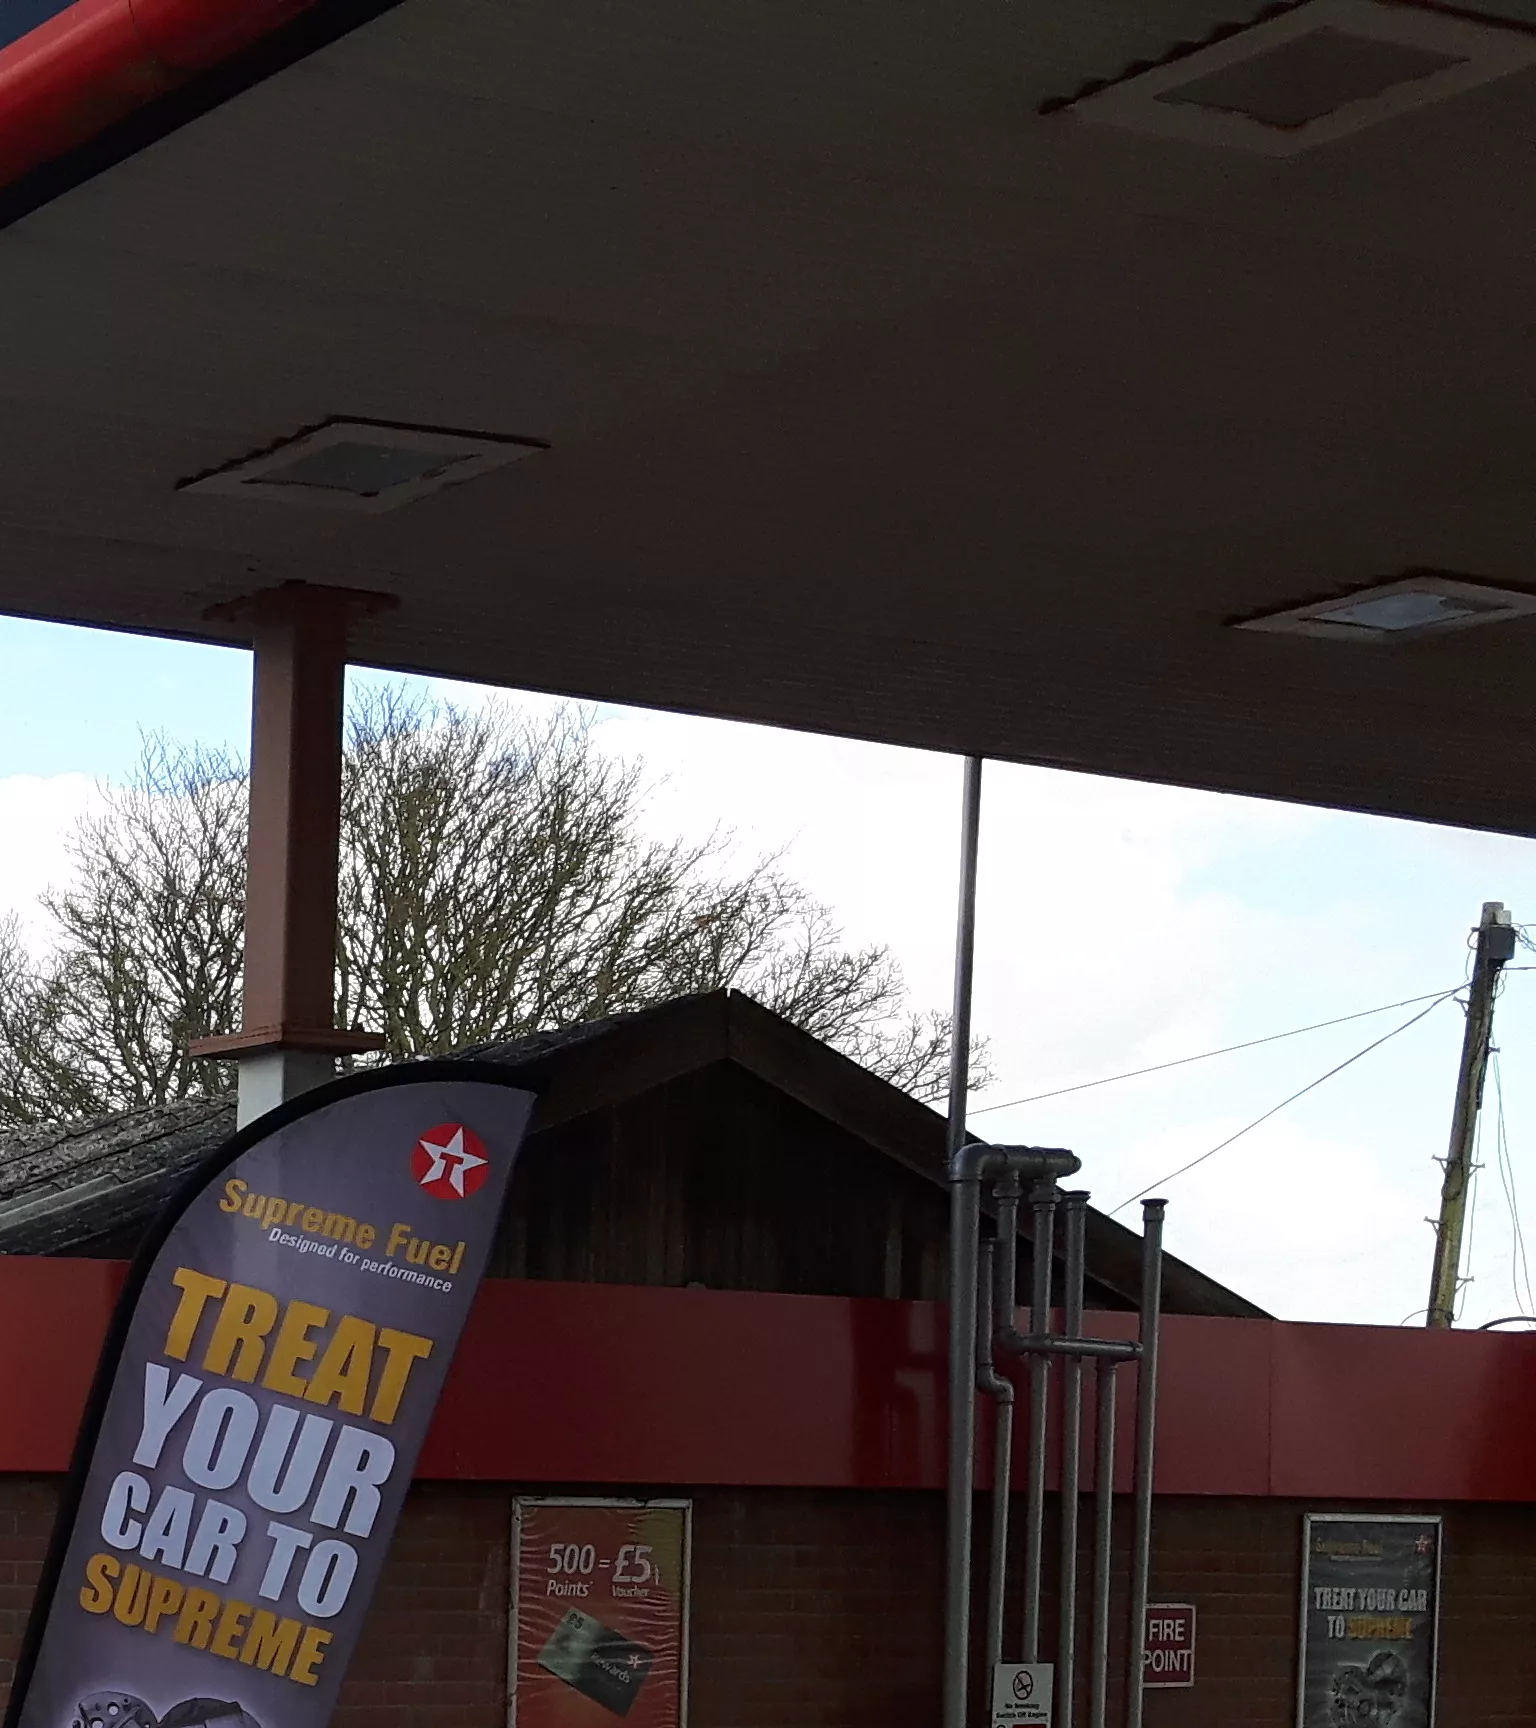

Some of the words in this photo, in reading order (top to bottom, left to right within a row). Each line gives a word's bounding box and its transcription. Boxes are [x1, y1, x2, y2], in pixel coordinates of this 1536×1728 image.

[219, 1178, 376, 1250] Supreme
[385, 1223, 466, 1275] Fuel
[268, 1227, 337, 1258] Designed
[338, 1247, 360, 1265] for
[360, 1258, 452, 1293] performance
[163, 1267, 434, 1425] TREAT
[132, 1362, 396, 1538] YOUR
[101, 1471, 247, 1584] CAR
[258, 1521, 359, 1618] TO
[547, 1543, 596, 1574] 500
[612, 1544, 653, 1583] £5
[79, 1552, 334, 1686] SUPREME
[612, 1585, 649, 1597] Voucher
[1314, 1587, 1356, 1611] TREAT
[1357, 1587, 1396, 1611] YOUR
[1397, 1589, 1427, 1612] CAR
[1149, 1619, 1185, 1641] FIRE
[1328, 1613, 1346, 1638] TO
